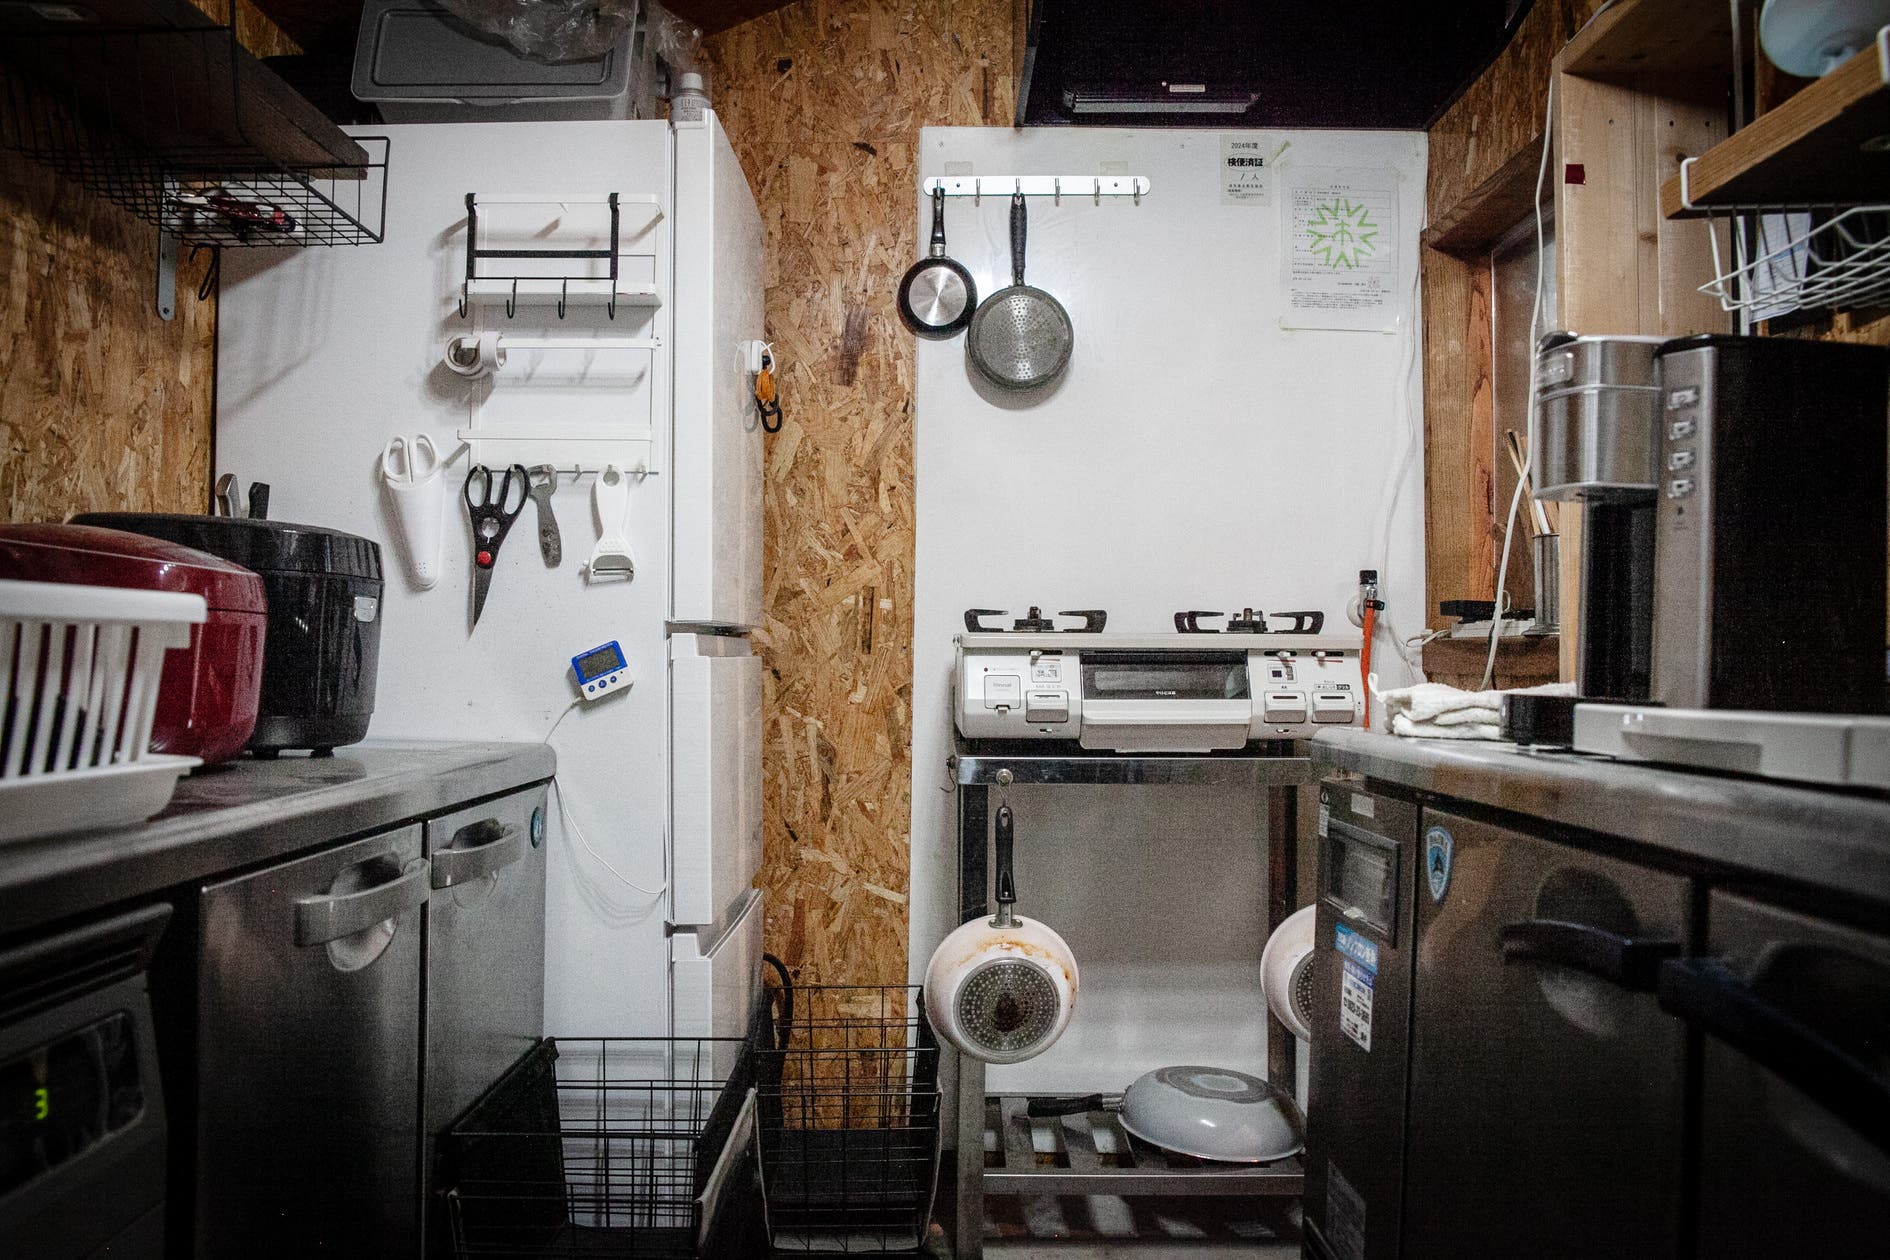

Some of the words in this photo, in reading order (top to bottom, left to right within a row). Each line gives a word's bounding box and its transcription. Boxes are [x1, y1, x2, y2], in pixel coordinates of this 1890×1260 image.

[1227, 157, 1263, 167] 検便済証
[35, 1088, 49, 1120] 3
